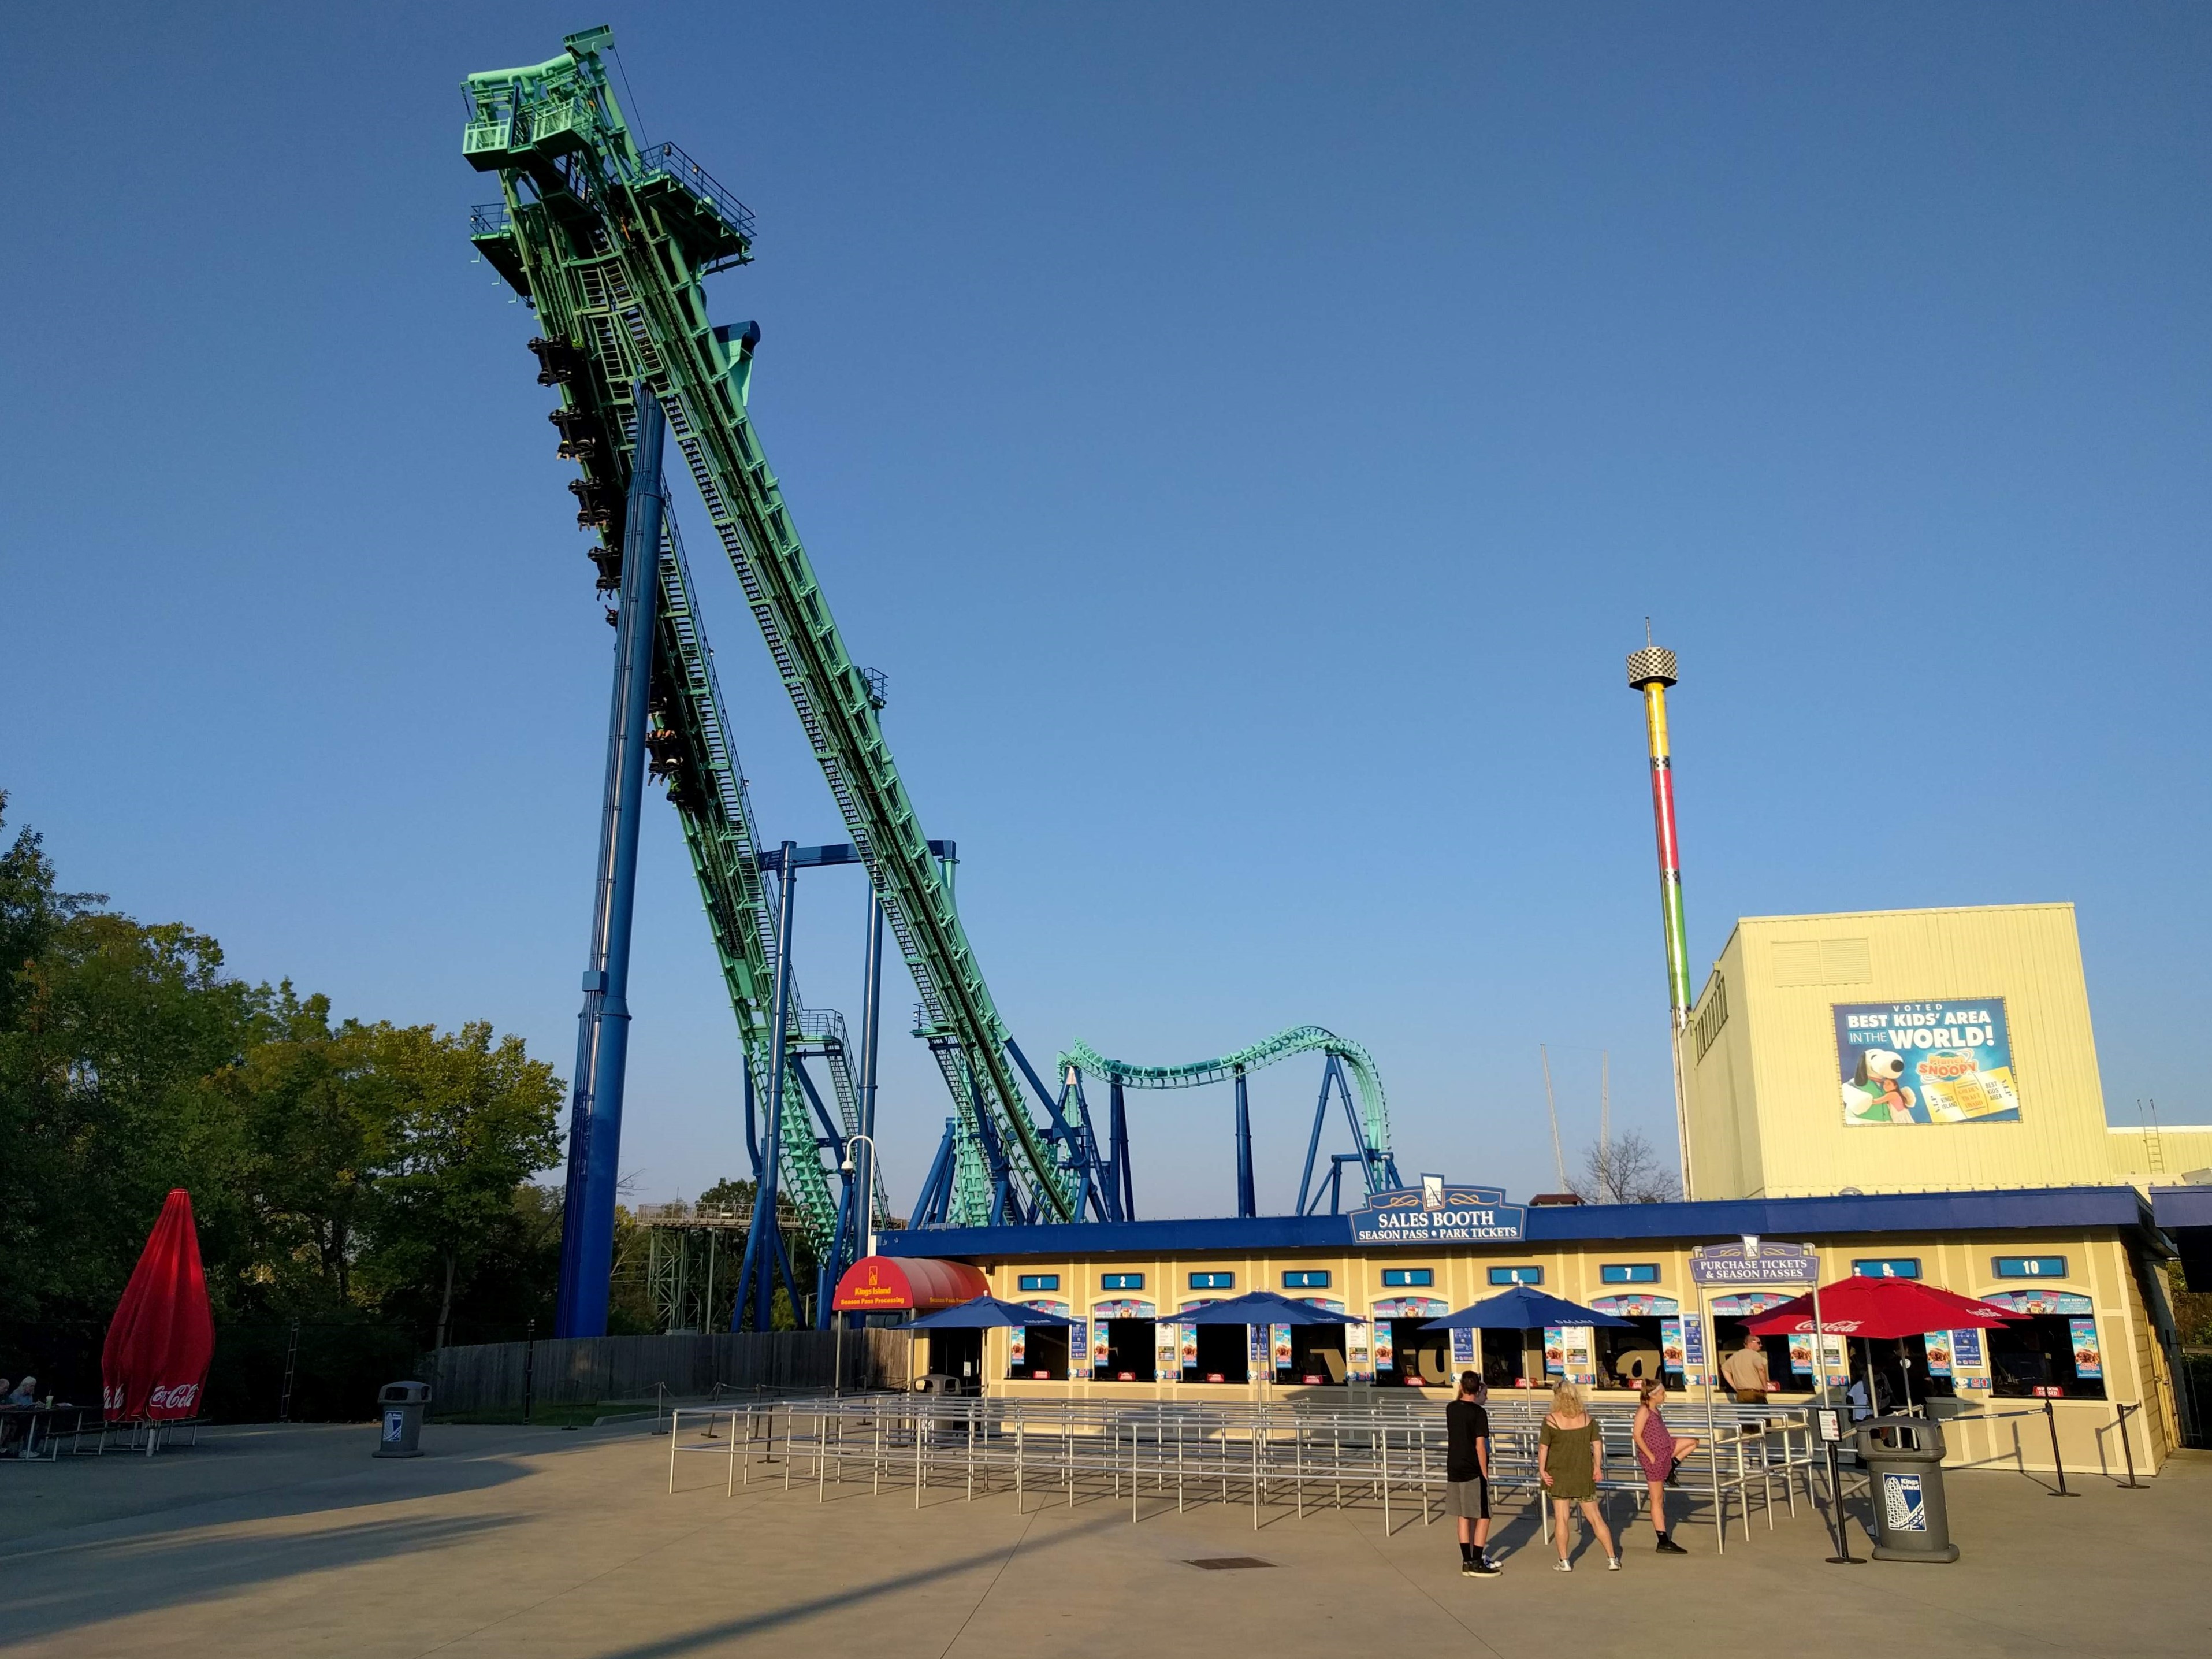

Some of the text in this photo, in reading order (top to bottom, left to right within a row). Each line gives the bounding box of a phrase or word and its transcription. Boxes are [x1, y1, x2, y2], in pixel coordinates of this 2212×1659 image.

[1893, 1004, 1943, 1012] VOTED
[1847, 1011, 1991, 1029] BEST KIDS' AREA
[1850, 1025, 1995, 1049] IN THE WORLD!
[1919, 1062, 1976, 1077] SNOOPY
[1990, 1093, 2003, 1101] AREA
[1379, 1211, 1495, 1228] SALES BOOTH
[1359, 1227, 1518, 1241] SEASON PASS PARK TICKETS
[1700, 1259, 1808, 1270] PURCHASE TICKETS
[2023, 1261, 2039, 1275] 10
[1404, 1272, 1411, 1283] 5
[1511, 1270, 1518, 1282] 6
[1625, 1268, 1632, 1279] 7
[1717, 1270, 1760, 1278] SEASON
[1763, 1269, 1804, 1278] PASSES
[1037, 1278, 1042, 1288] 1
[1120, 1276, 1126, 1287] 2
[1208, 1275, 1214, 1286] 3
[1302, 1274, 1309, 1285] 4
[855, 1287, 872, 1296] Kings
[875, 1297, 905, 1305] Processing
[1795, 1320, 1865, 1333] Coa-Cola
